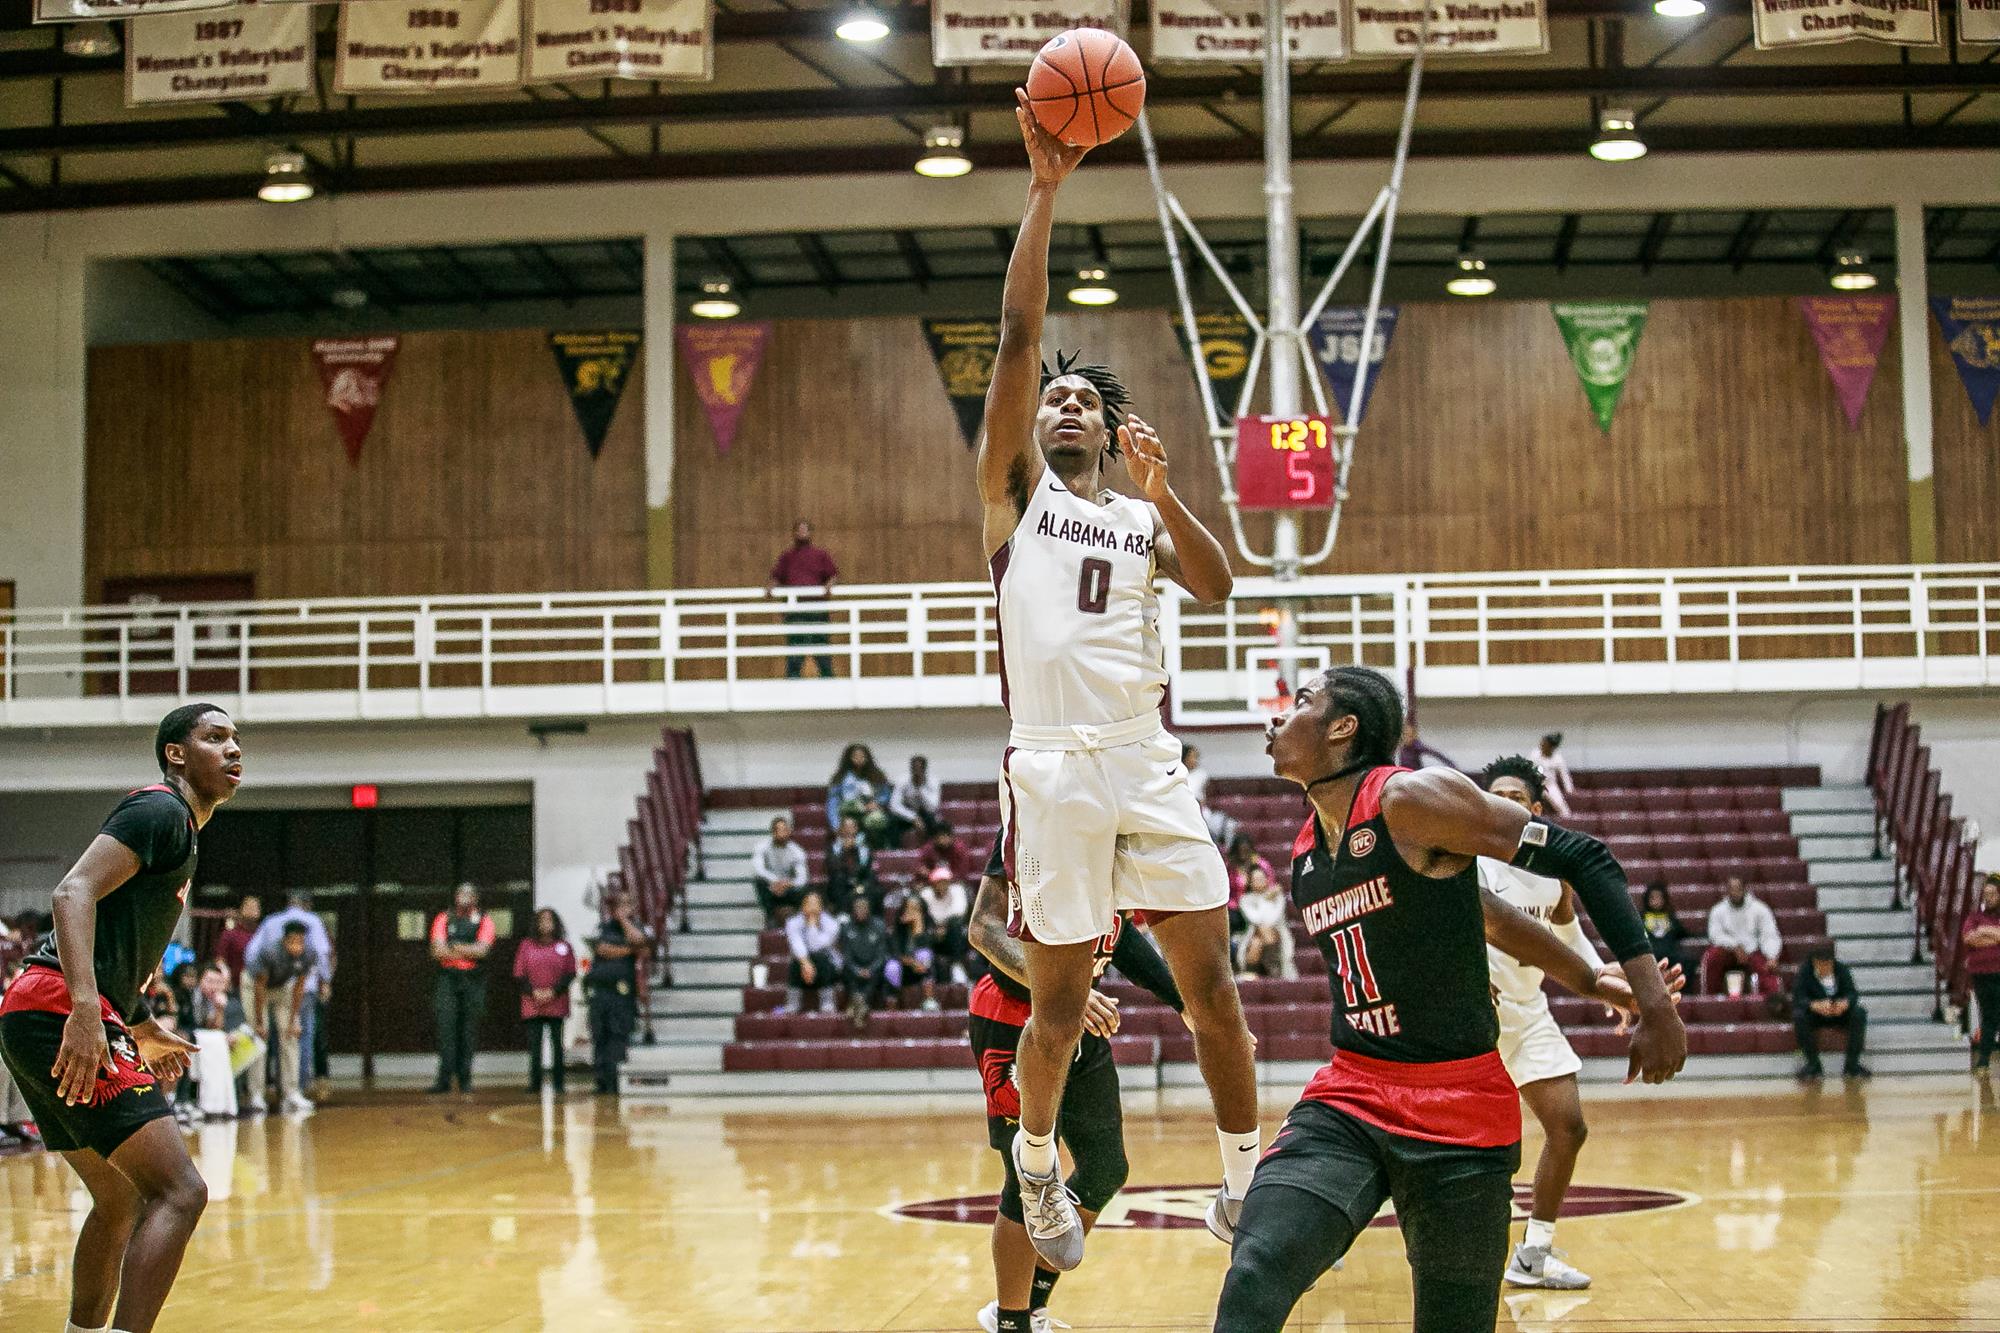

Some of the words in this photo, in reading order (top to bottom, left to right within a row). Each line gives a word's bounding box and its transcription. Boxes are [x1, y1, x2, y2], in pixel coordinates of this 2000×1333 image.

[1358, 8, 1438, 22] Womens
[1445, 2, 1536, 21] Volleyball
[1802, 13, 1896, 31] Champions
[349, 43, 423, 58] Women's
[431, 39, 516, 59] Volleyball
[537, 27, 607, 46] Women's
[614, 25, 700, 46] Volleyball
[137, 53, 212, 72] Women's
[219, 47, 304, 68] Volleyball
[382, 64, 480, 81] Champions
[172, 73, 267, 91] Champions
[1271, 420, 1327, 451] 1:27
[1287, 450, 1315, 499] 5
[1037, 510, 1117, 550] ALABAMA
[1076, 556, 1113, 614] 0
[1302, 876, 1394, 936] ACKSONVILLE
[1330, 923, 1382, 1007] 11
[1344, 1004, 1400, 1037] ATE
